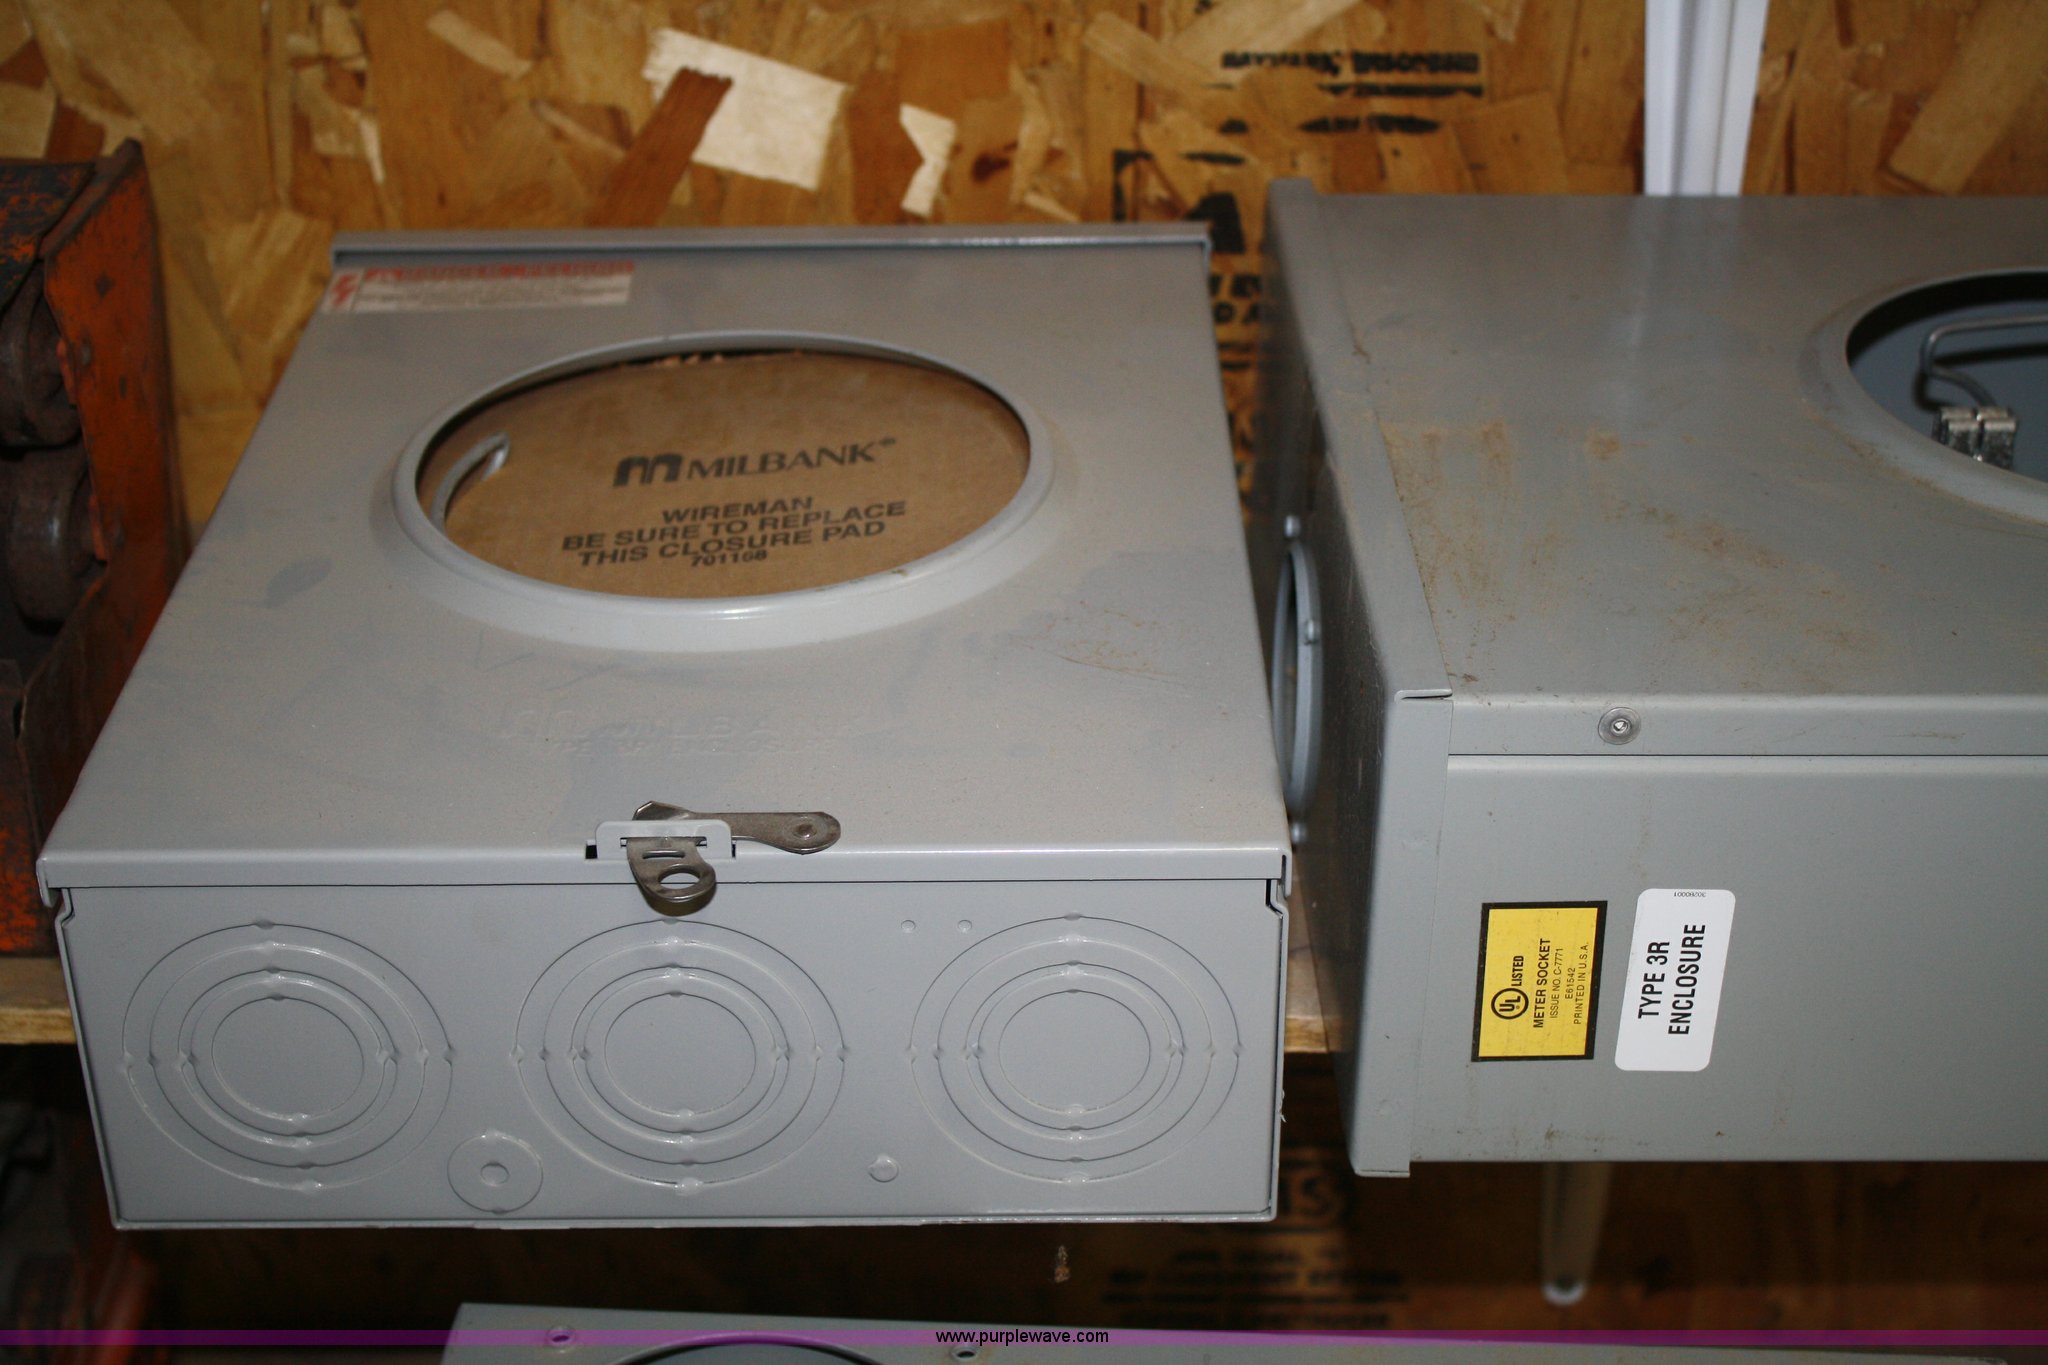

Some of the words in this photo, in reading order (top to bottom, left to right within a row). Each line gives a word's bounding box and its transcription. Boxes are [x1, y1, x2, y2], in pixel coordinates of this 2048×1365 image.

[686, 443, 876, 480] MILBANK
[562, 532, 606, 552] BE
[613, 524, 700, 547] SURE
[707, 520, 748, 537] TO
[757, 500, 907, 532] REPLACE
[661, 497, 814, 525] WIREMAN
[577, 546, 649, 567] THIS
[658, 529, 812, 559] CLOSURE
[822, 520, 886, 542] PAD
[1537, 938, 1551, 986] SOCKET
[1553, 948, 1564, 976] C-7771
[1578, 942, 1589, 969] U.S.A.
[1646, 941, 1670, 966] 3R
[1511, 955, 1524, 987] LISTED
[1552, 977, 1561, 992] NO.
[1565, 967, 1575, 999] E61542
[1577, 972, 1586, 982] IN
[1668, 924, 1706, 1035] ENCLOSURE
[1533, 989, 1547, 1029] METER
[1550, 994, 1560, 1018] ISSUE
[1573, 985, 1585, 1025] PRINTED
[1637, 972, 1665, 1020] TYPE
